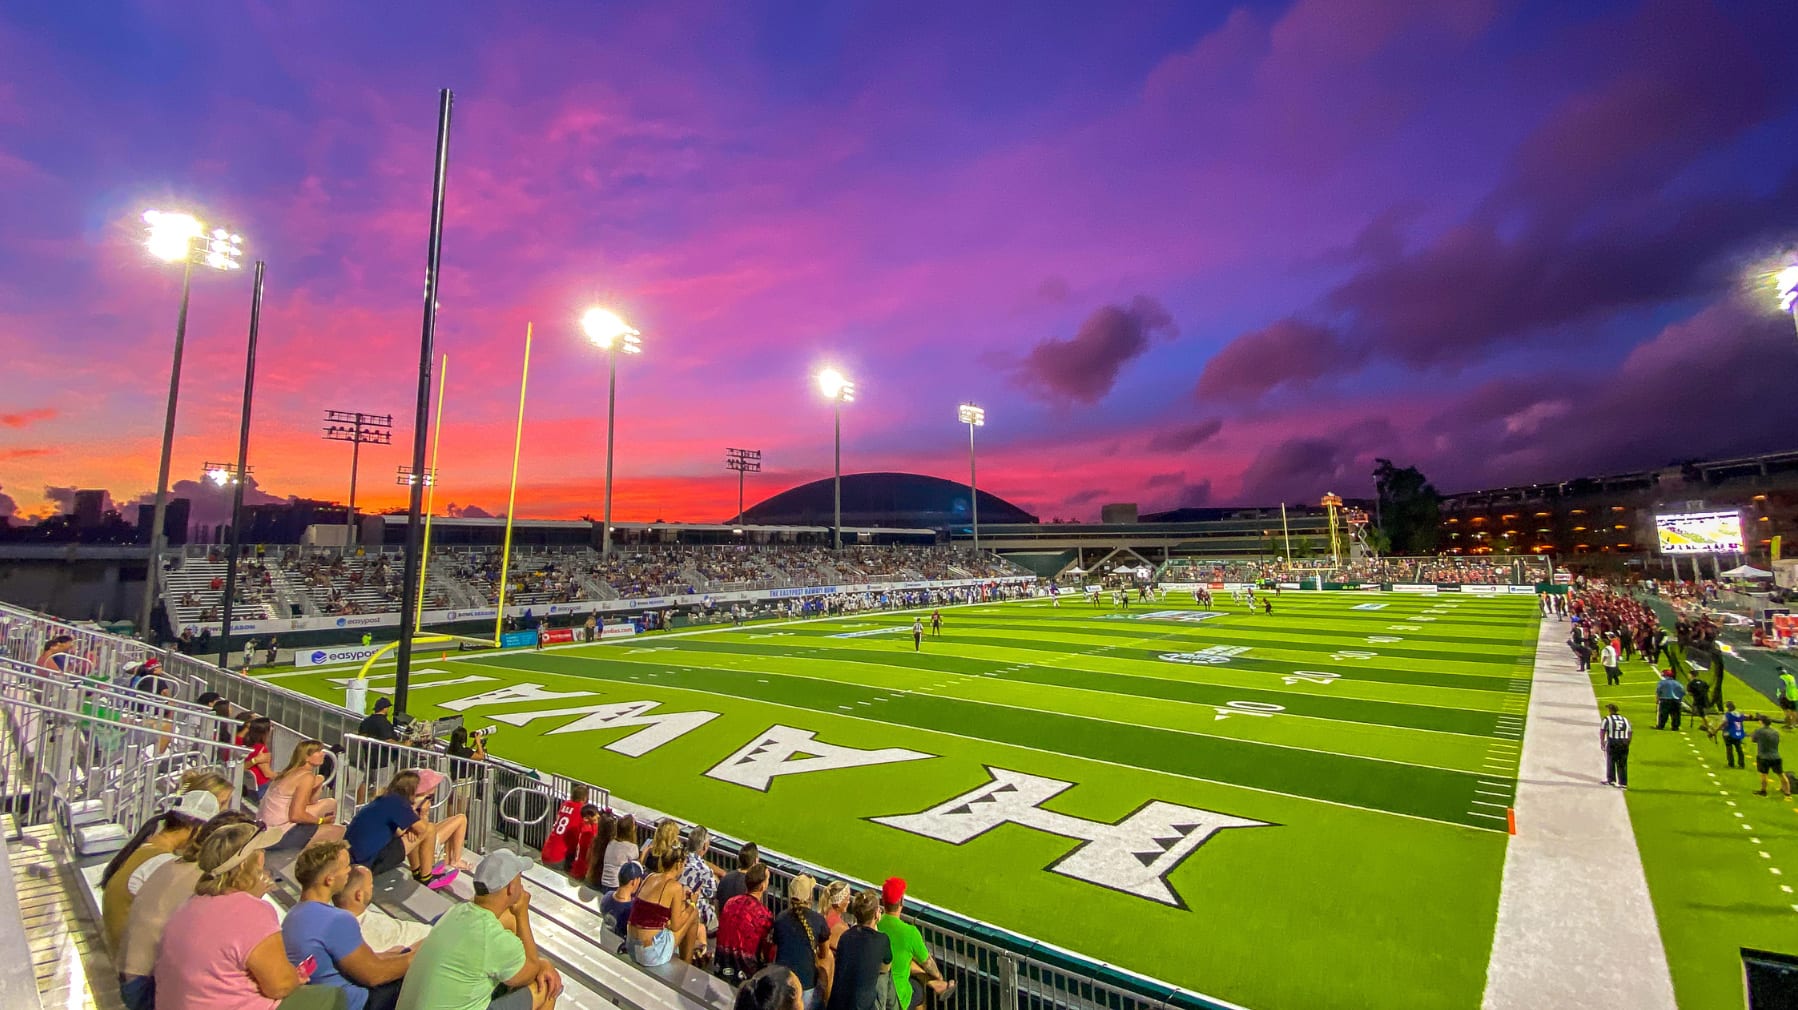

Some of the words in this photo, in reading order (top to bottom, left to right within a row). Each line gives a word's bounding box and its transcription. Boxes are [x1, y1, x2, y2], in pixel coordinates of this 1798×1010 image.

[347, 617, 380, 625] easypost
[1281, 671, 1342, 684] 20
[1214, 701, 1286, 718] 10
[1615, 720, 1624, 730] F
